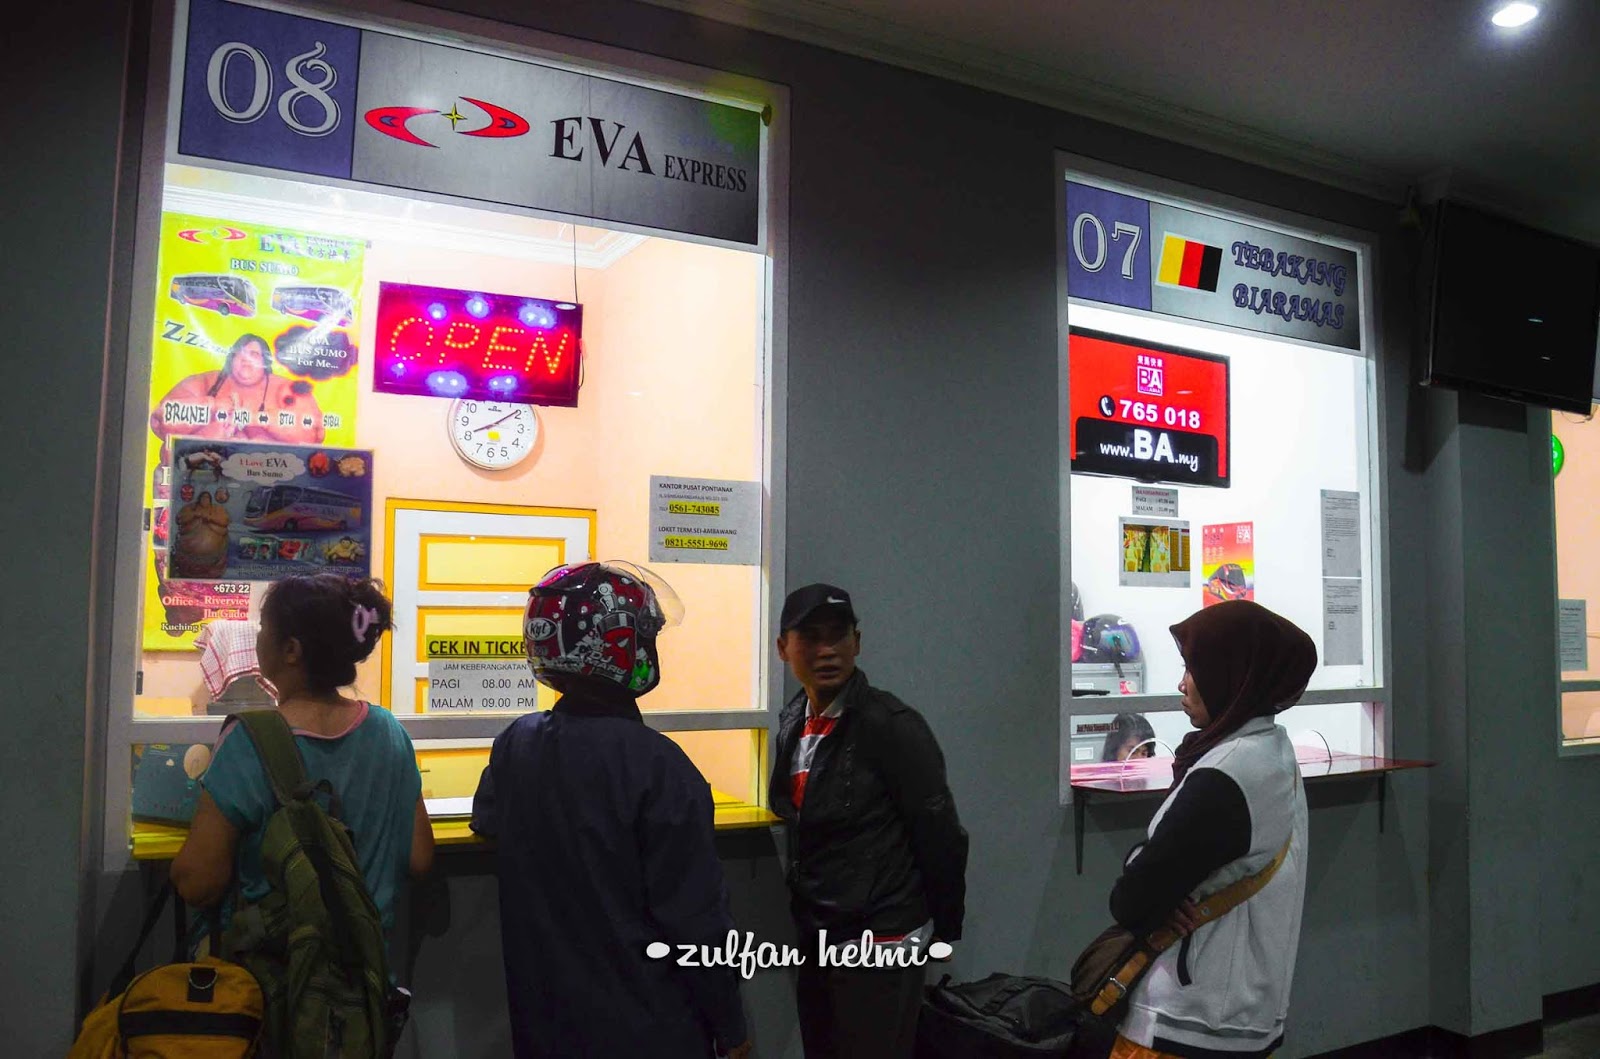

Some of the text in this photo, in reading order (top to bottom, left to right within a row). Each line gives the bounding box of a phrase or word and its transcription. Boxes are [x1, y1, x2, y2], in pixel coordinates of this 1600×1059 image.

[207, 41, 342, 136] 08
[550, 116, 747, 192] EVA EXPRESS
[1073, 212, 1141, 280] 07
[231, 258, 256, 271] BUS
[1232, 240, 1346, 295] TEBAKANG
[1233, 284, 1344, 329] BIARAMAS
[389, 317, 569, 374] OPEN
[314, 348, 347, 358] SUMO
[297, 358, 313, 367] For
[165, 402, 209, 424] BRUNEI
[466, 403, 477, 413] 10
[514, 409, 522, 420] 2
[1119, 399, 1200, 429] 765 018
[461, 416, 469, 426] 9
[517, 424, 525, 434] 3
[464, 430, 472, 441] 8
[476, 443, 483, 453] 7
[512, 438, 519, 448] 4
[486, 447, 495, 458] 6
[500, 447, 508, 457] 5
[1100, 428, 1199, 472] www.BA.my
[266, 457, 288, 468] EVA
[665, 538, 728, 548] 0821-5551-9696
[213, 583, 236, 593] +673
[162, 596, 194, 606] Office
[161, 622, 199, 632] Kuching
[429, 641, 458, 654] CEK
[464, 641, 480, 654] IN
[432, 679, 535, 689] PAGI 08.00 AM
[431, 697, 534, 708] MALAM 09.00 PM
